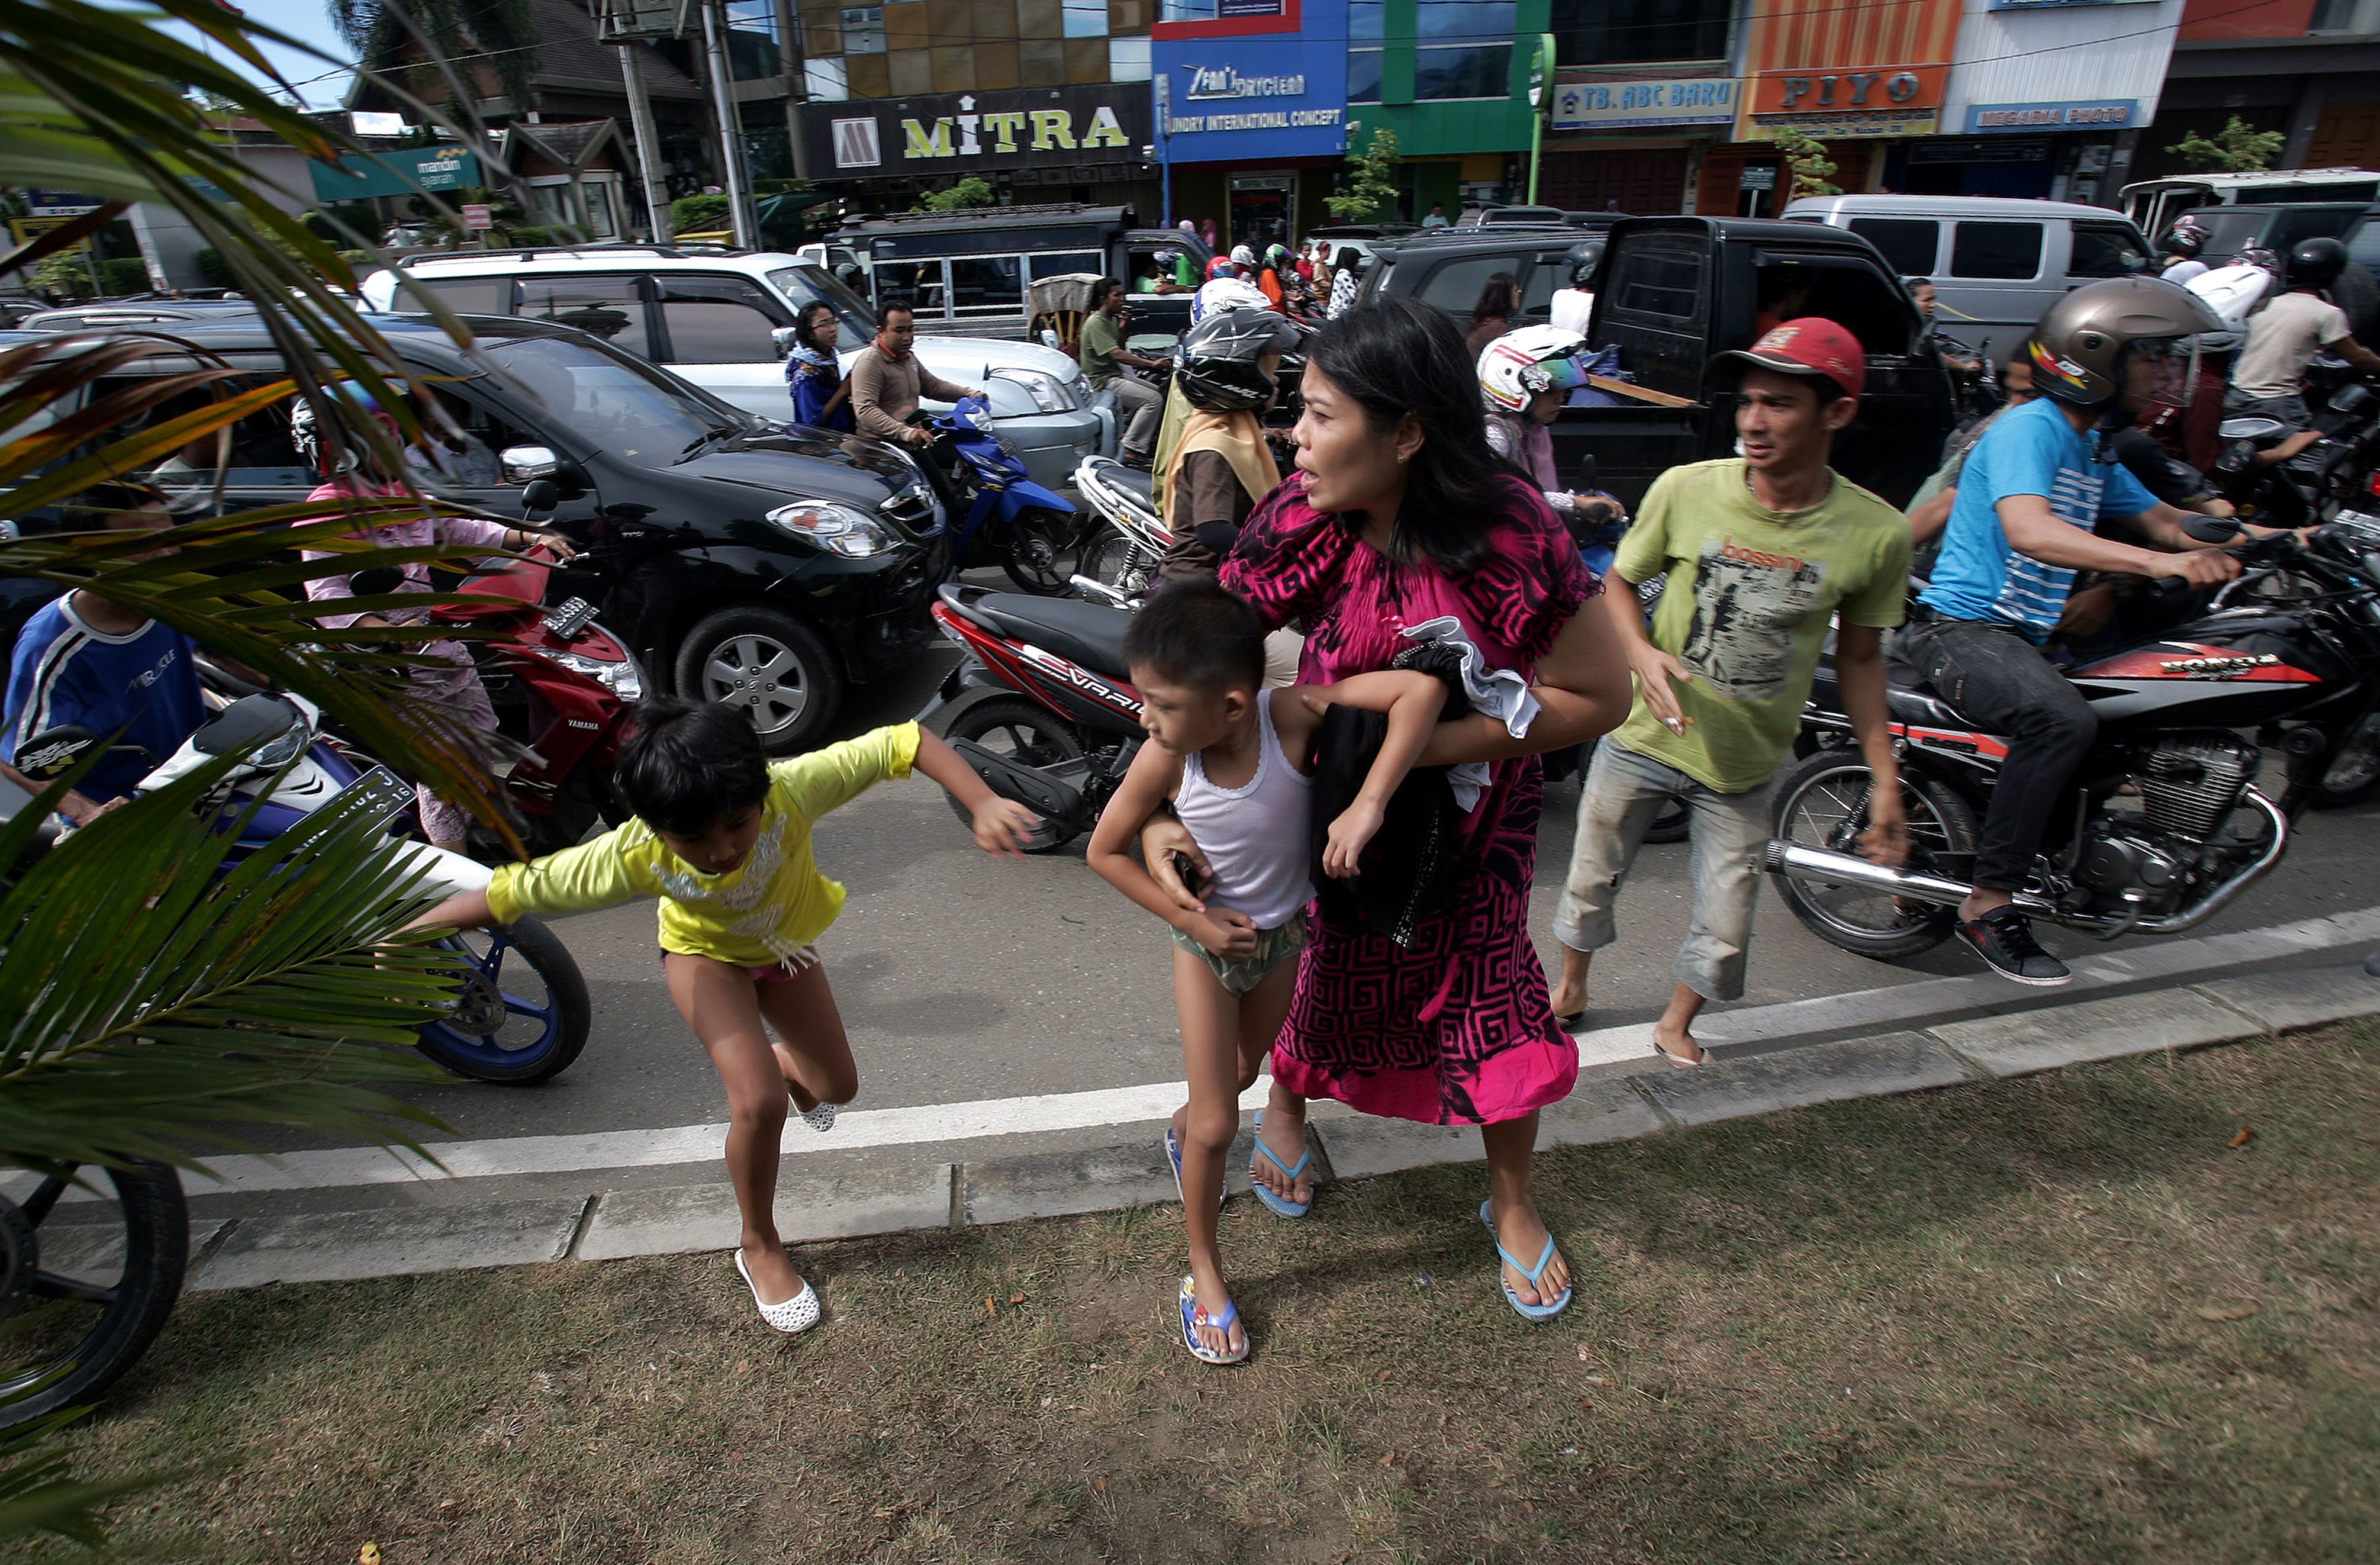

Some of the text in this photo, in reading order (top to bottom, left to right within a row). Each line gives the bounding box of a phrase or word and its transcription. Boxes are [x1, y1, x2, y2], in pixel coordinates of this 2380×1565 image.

[1582, 82, 1732, 110] TB. ABC BARU
[1780, 72, 1920, 107] PIYO
[1206, 112, 1290, 131] INTERNATIONAL
[1291, 109, 1342, 127] CONCEPT
[1722, 534, 1807, 572] bossini
[1069, 667, 1144, 714] VARI
[568, 719, 599, 730] YAMAHA
